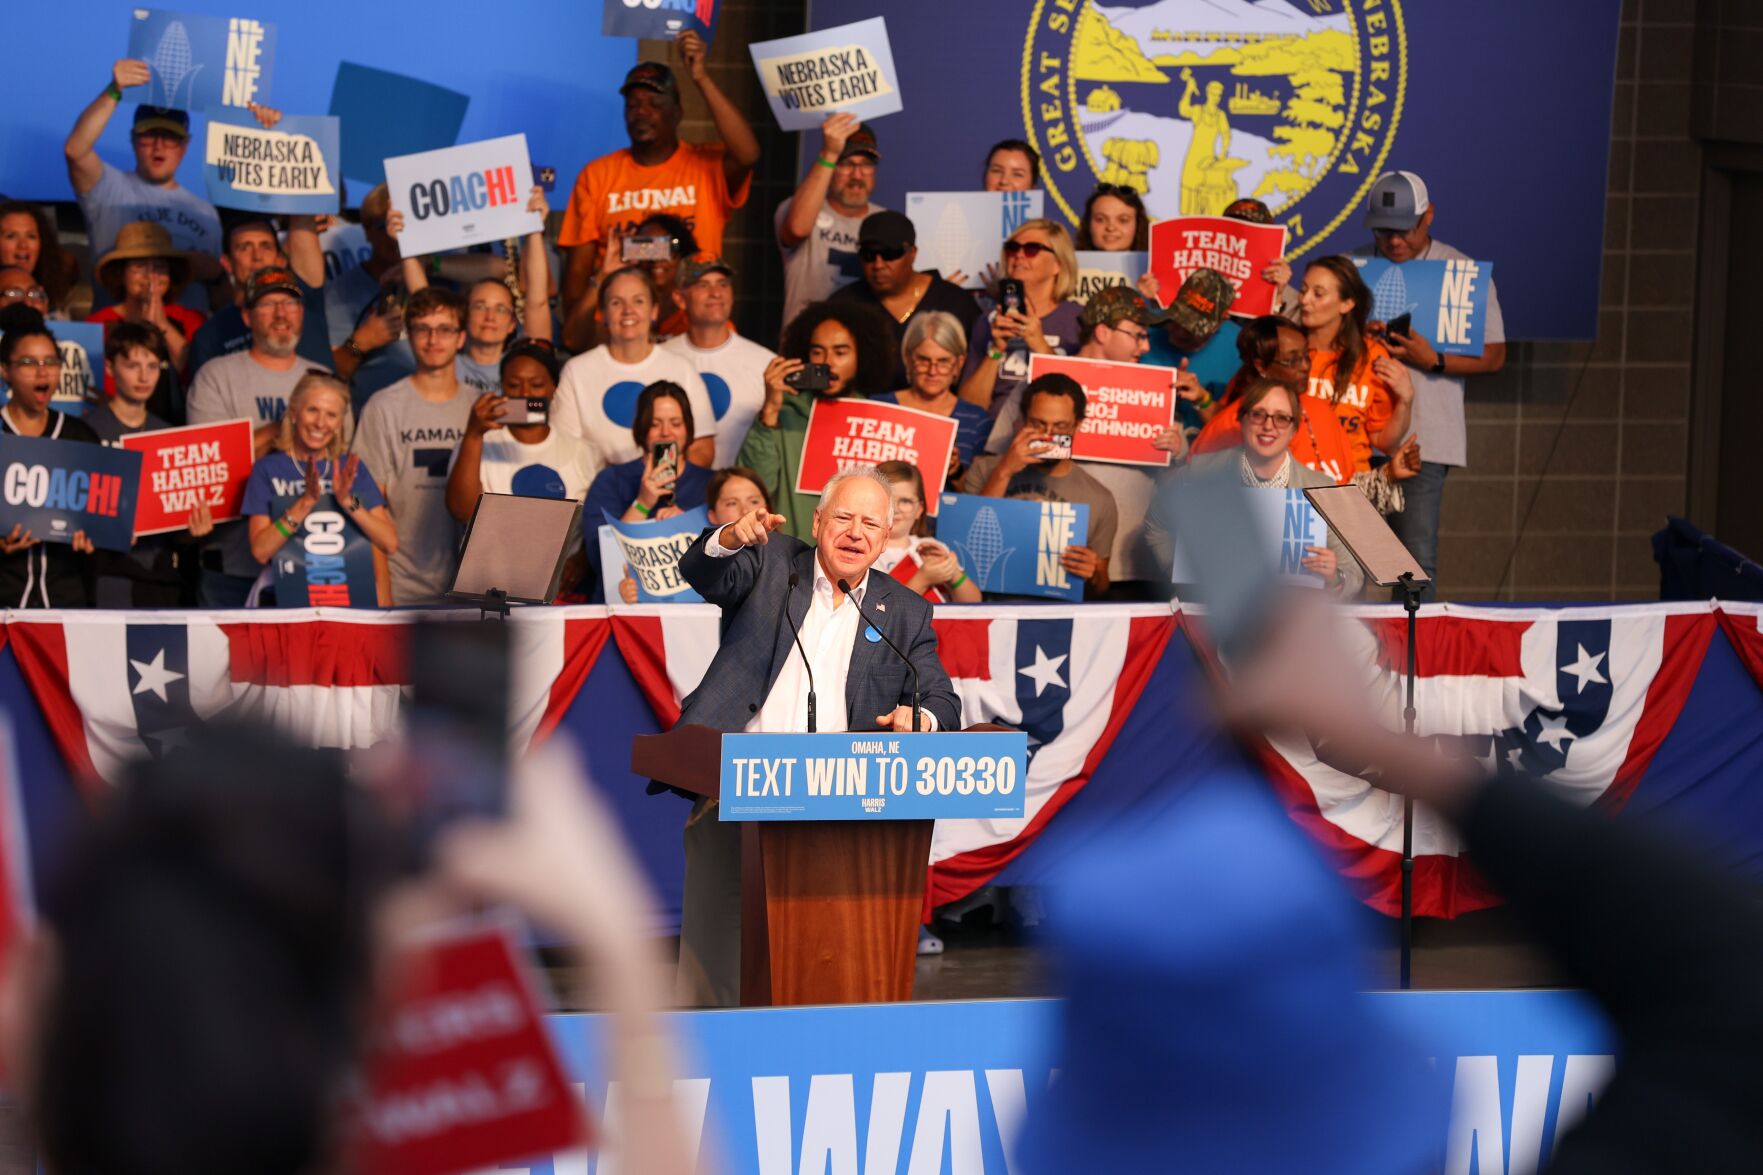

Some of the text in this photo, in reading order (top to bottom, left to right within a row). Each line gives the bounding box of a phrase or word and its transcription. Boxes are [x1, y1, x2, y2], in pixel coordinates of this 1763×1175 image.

[225, 32, 264, 71] NE
[776, 48, 868, 87] NEBRASKA
[221, 68, 261, 107] NE
[778, 70, 878, 110] VOTES EARLY
[1039, 51, 1077, 172] GREAT
[223, 133, 313, 164] NEBRASKA
[217, 157, 322, 190] VOTES EARLY
[409, 164, 519, 221] COACH!
[819, 230, 861, 247] KAM
[1182, 230, 1248, 258] TEAM
[1173, 249, 1252, 280] HARRIS
[1074, 276, 1127, 297] ASKA
[1440, 271, 1478, 309] NE
[1436, 306, 1474, 345] NE
[63, 373, 90, 397] RLY
[254, 395, 288, 421] WA
[1085, 402, 1119, 420] FOR
[400, 427, 467, 444] KAMAH
[846, 416, 917, 447] TEAM
[1079, 417, 1164, 440] CORNHUS
[157, 440, 221, 469] TEAM
[832, 435, 919, 466] HARRIS
[4, 462, 122, 517] COACH!
[152, 462, 229, 493] HARRIS
[159, 484, 225, 514] WALZ
[1038, 515, 1077, 553] NE
[1283, 503, 1315, 540] NE
[624, 535, 695, 568] BRASKA
[851, 741, 900, 756] OMAHA, NE
[732, 756, 1016, 797] TEXT WIN TO 30330
[861, 798, 886, 808] HARRIS
